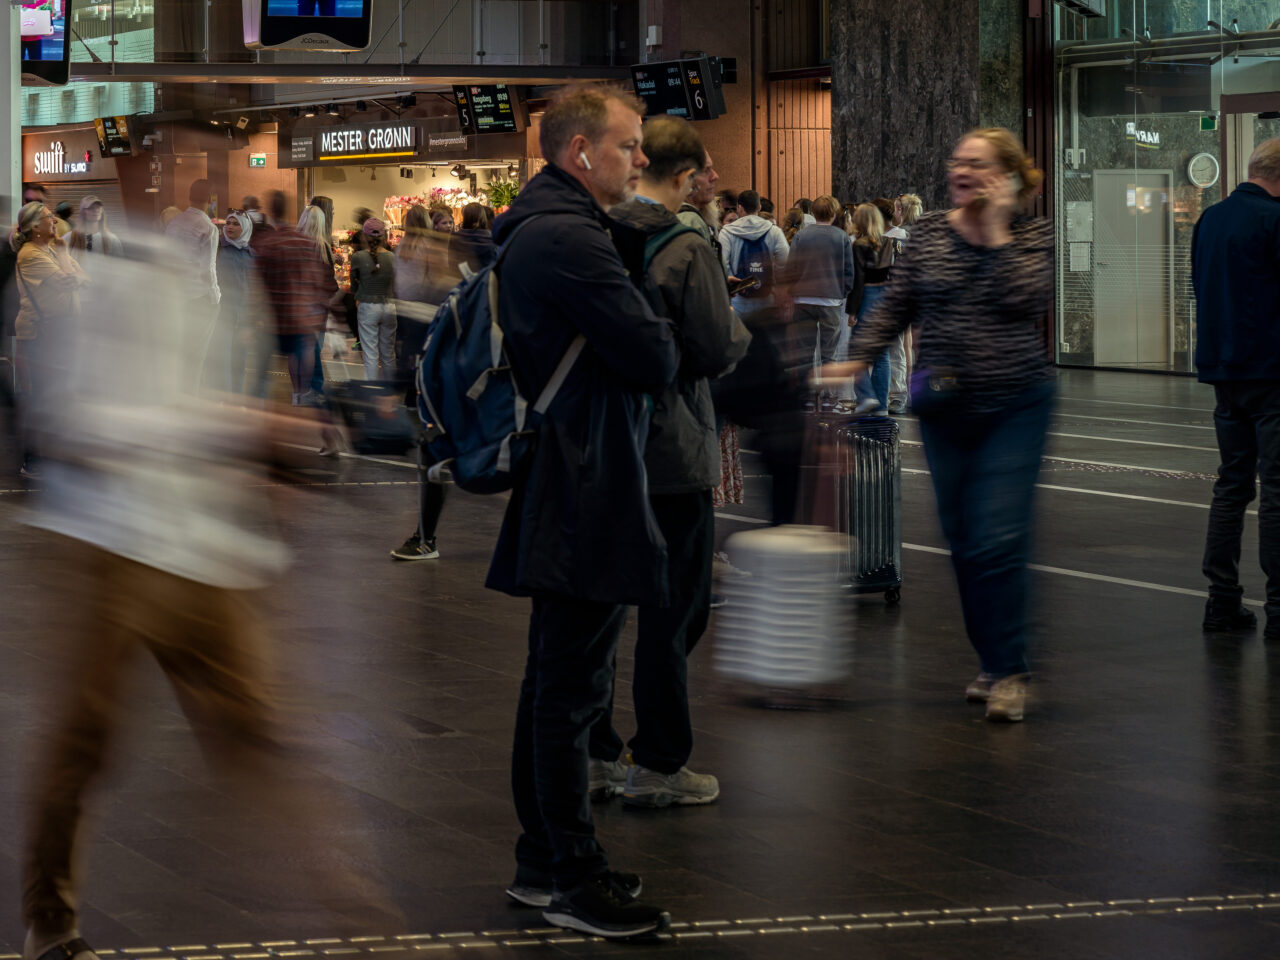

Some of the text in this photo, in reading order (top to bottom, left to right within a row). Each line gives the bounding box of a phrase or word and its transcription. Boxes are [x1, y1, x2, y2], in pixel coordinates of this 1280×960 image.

[694, 89, 703, 109] 6
[462, 108, 469, 126] 5
[321, 126, 411, 152] MESTER GRØNN
[34, 141, 64, 174] swift
[64, 162, 87, 173] BY SUMO
